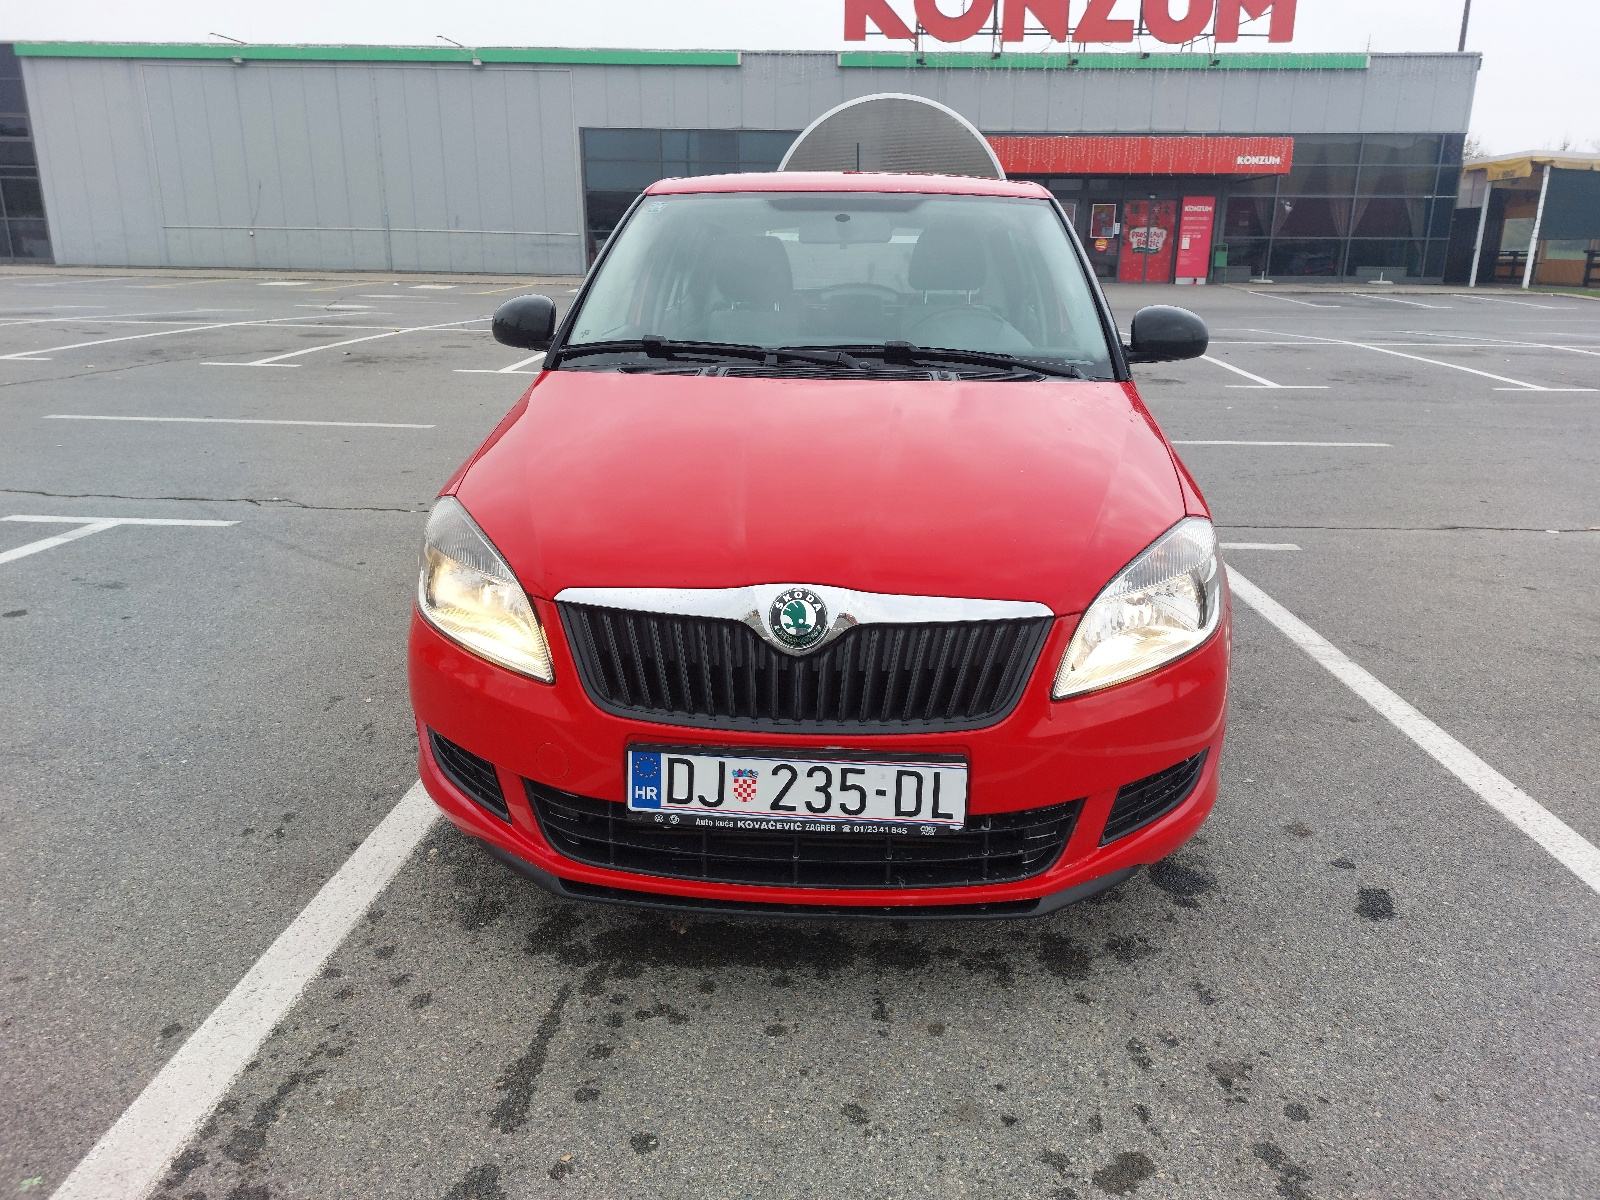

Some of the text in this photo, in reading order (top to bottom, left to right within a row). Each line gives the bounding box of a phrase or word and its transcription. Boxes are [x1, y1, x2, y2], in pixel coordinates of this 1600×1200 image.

[1236, 155, 1281, 165] KONZUM
[634, 786, 659, 801] HR
[666, 757, 955, 820] DJ 235-DL
[695, 817, 713, 827] Auto
[715, 818, 735, 828] kuća
[737, 819, 803, 831] KOVAČEVIĆ
[805, 823, 836, 832] ZAGREB
